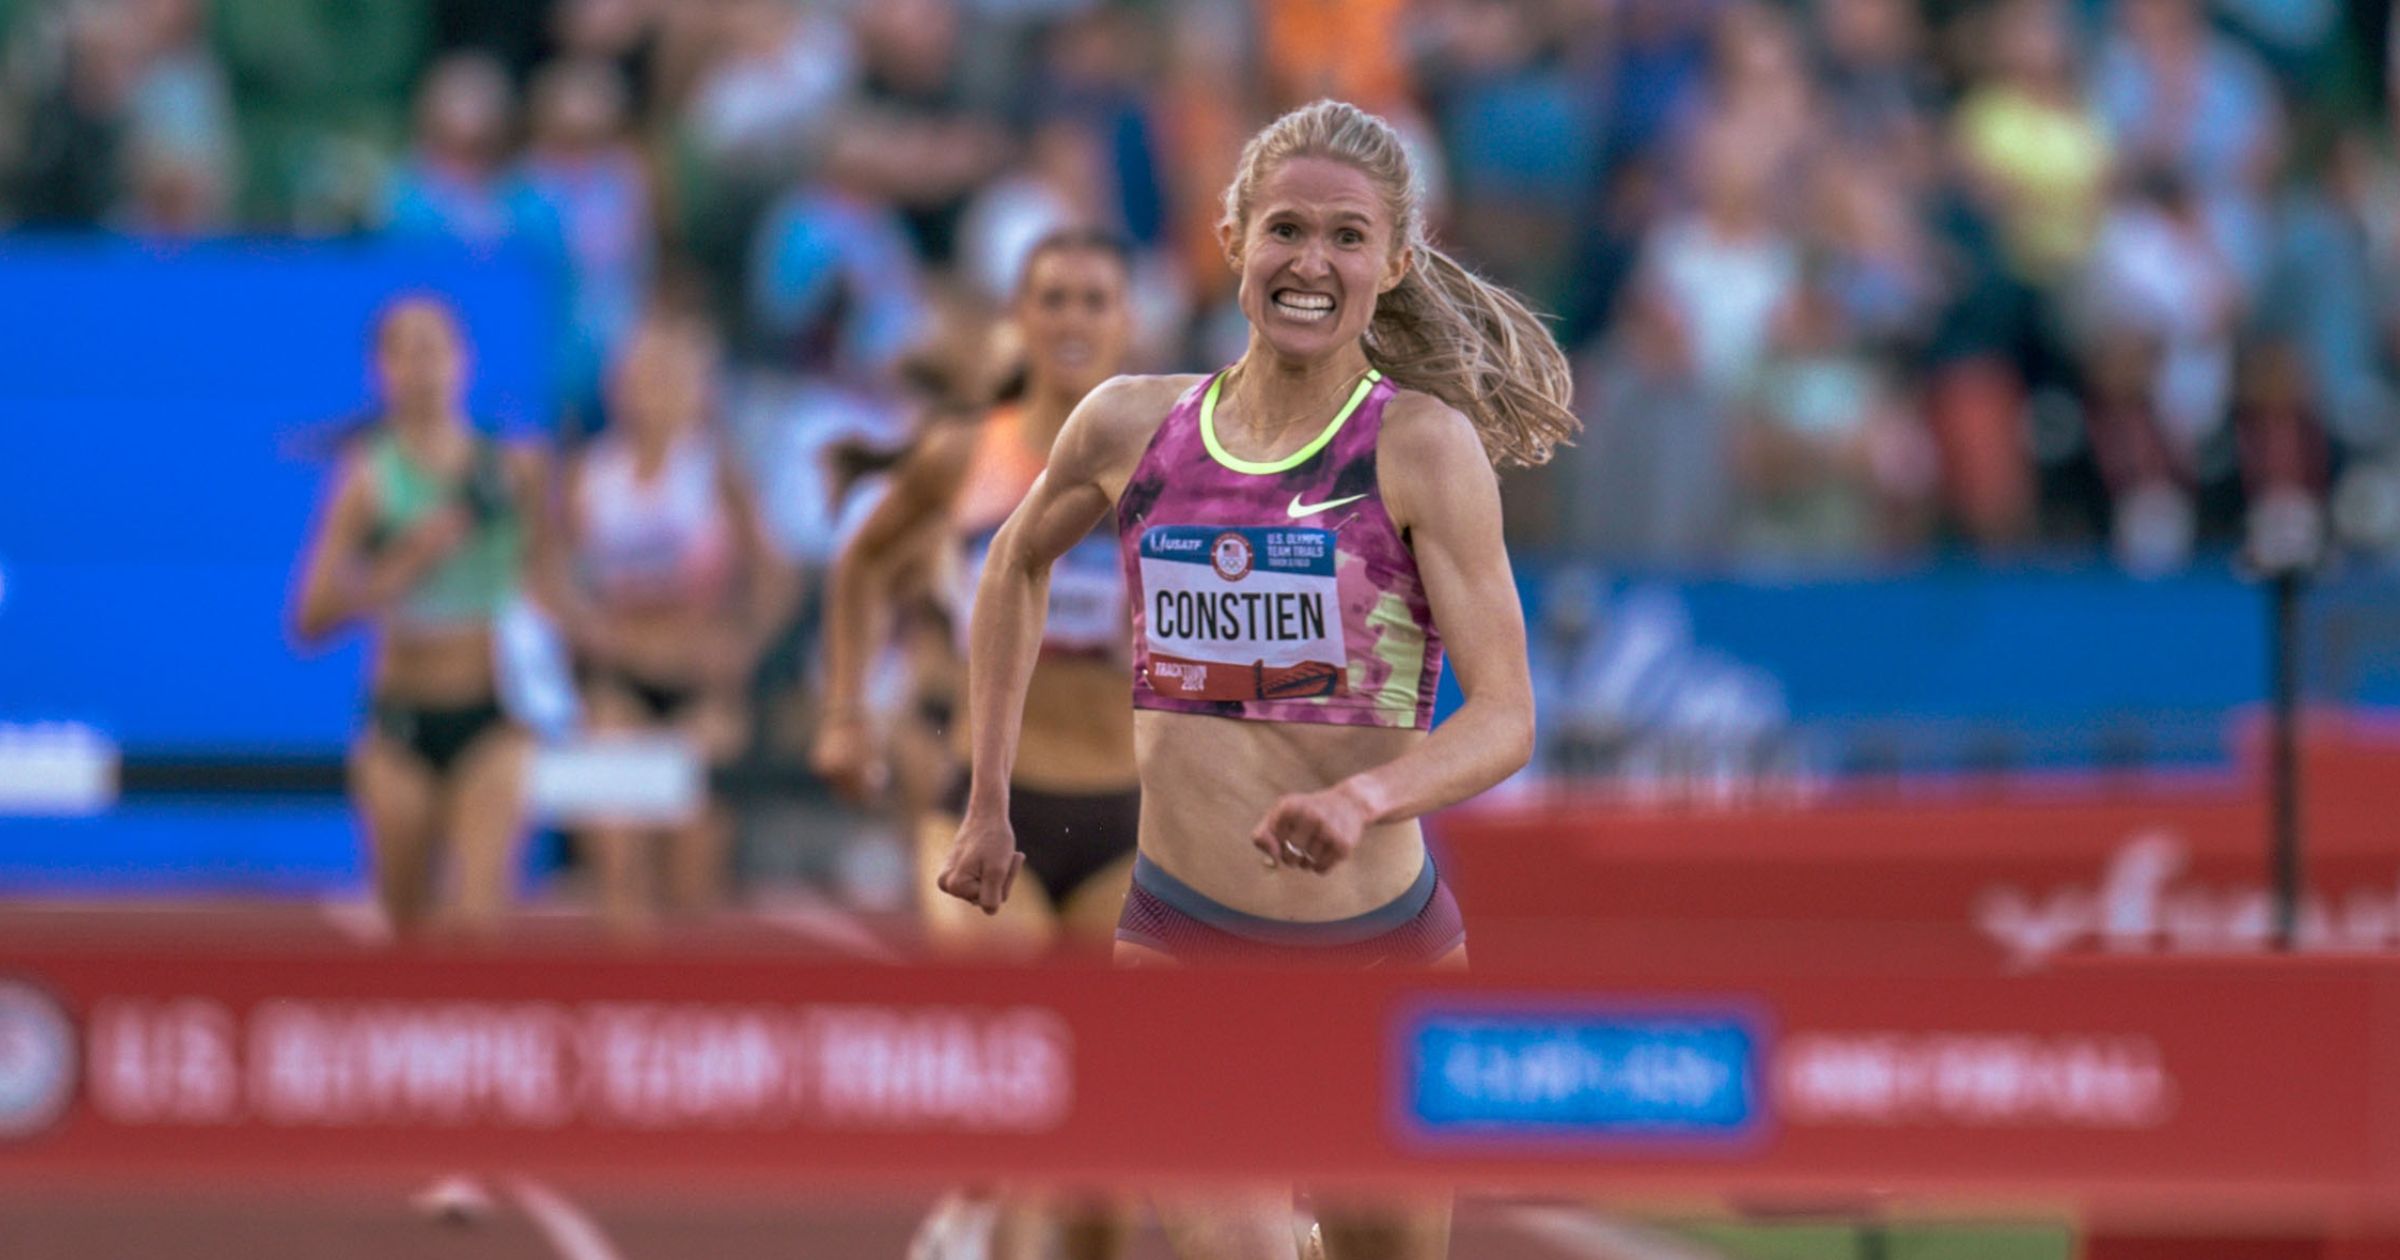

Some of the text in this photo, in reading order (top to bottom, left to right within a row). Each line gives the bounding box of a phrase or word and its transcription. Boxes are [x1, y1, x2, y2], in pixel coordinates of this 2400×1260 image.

[1166, 539, 1203, 551] USATF
[1286, 533, 1325, 546] OLYMPIC
[1267, 546, 1325, 558] TEAM TRIALS
[1156, 590, 1325, 641] CONSTIEN
